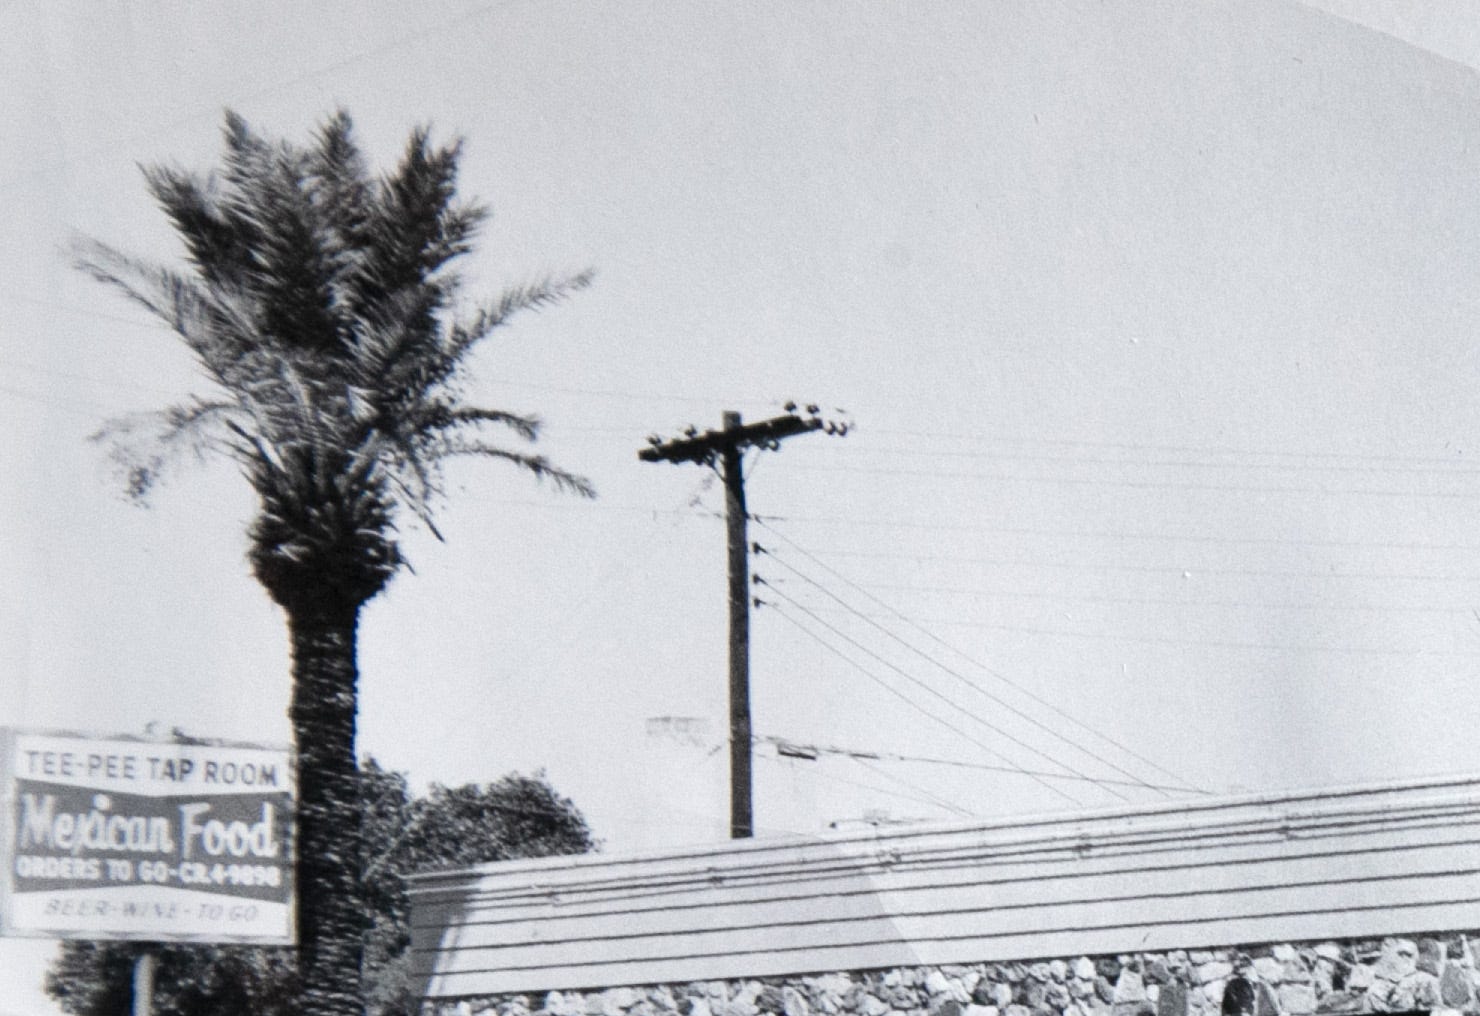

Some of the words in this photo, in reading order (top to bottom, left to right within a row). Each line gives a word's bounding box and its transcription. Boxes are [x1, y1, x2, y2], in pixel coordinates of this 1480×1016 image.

[25, 751, 136, 779] TEE-PEE
[147, 758, 194, 781] TAP
[204, 761, 278, 786] ROOM
[21, 792, 174, 856] Mexican
[178, 801, 279, 858] Food
[16, 855, 100, 879] ORDERS
[106, 859, 132, 881] TO
[229, 904, 258, 922] GO
